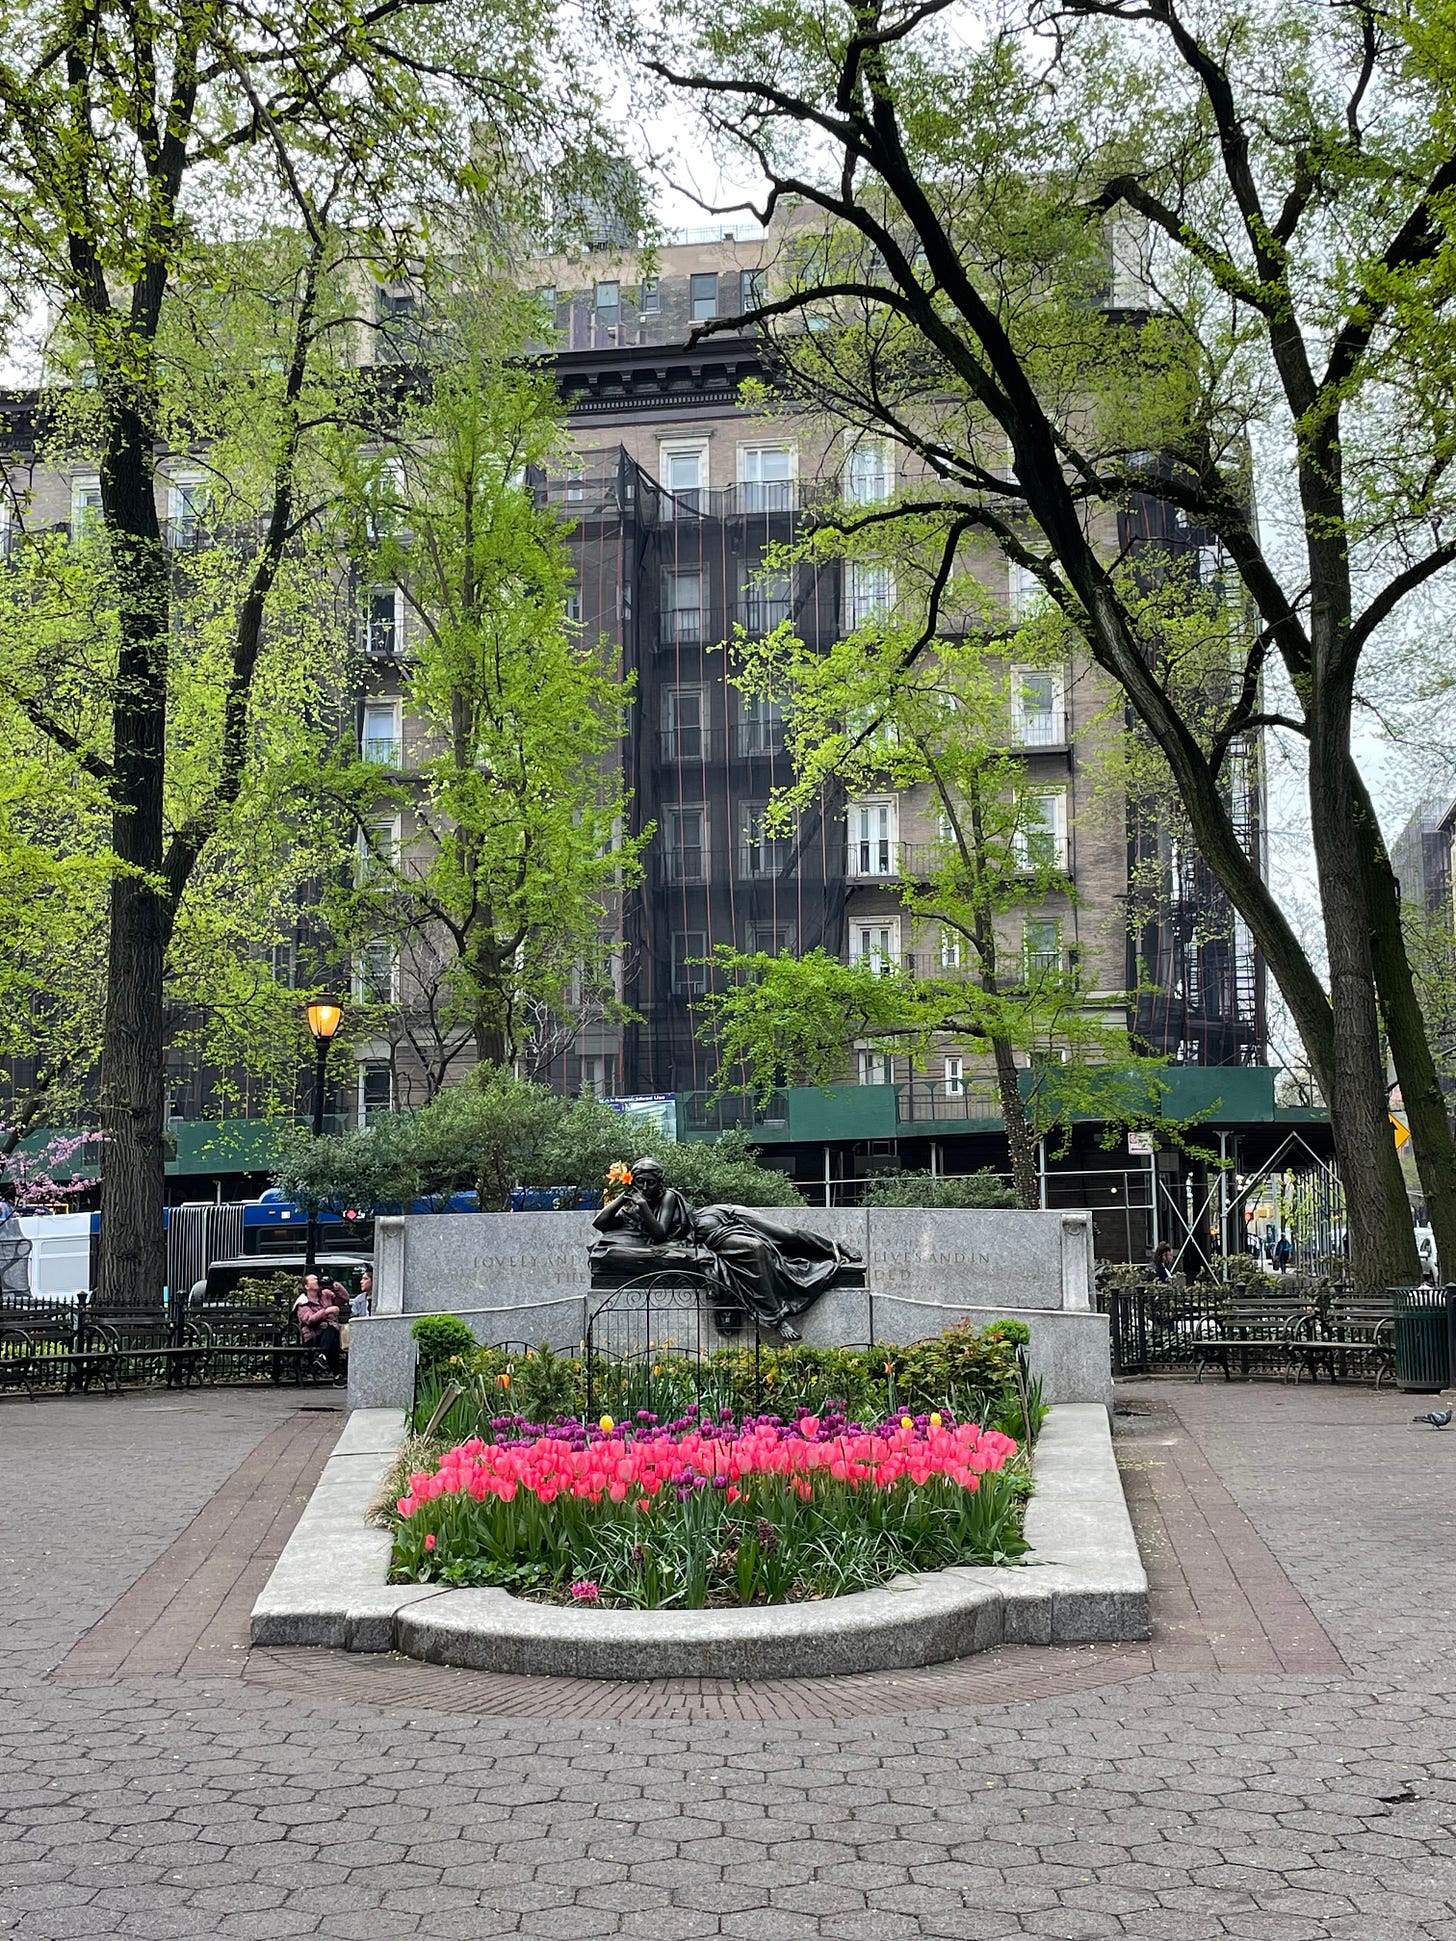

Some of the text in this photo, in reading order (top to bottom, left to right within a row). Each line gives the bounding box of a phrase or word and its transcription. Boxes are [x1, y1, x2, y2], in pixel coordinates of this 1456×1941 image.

[473, 1254, 538, 1269] LOVELY
[873, 1251, 922, 1264] LIVES
[929, 1252, 965, 1264] AND
